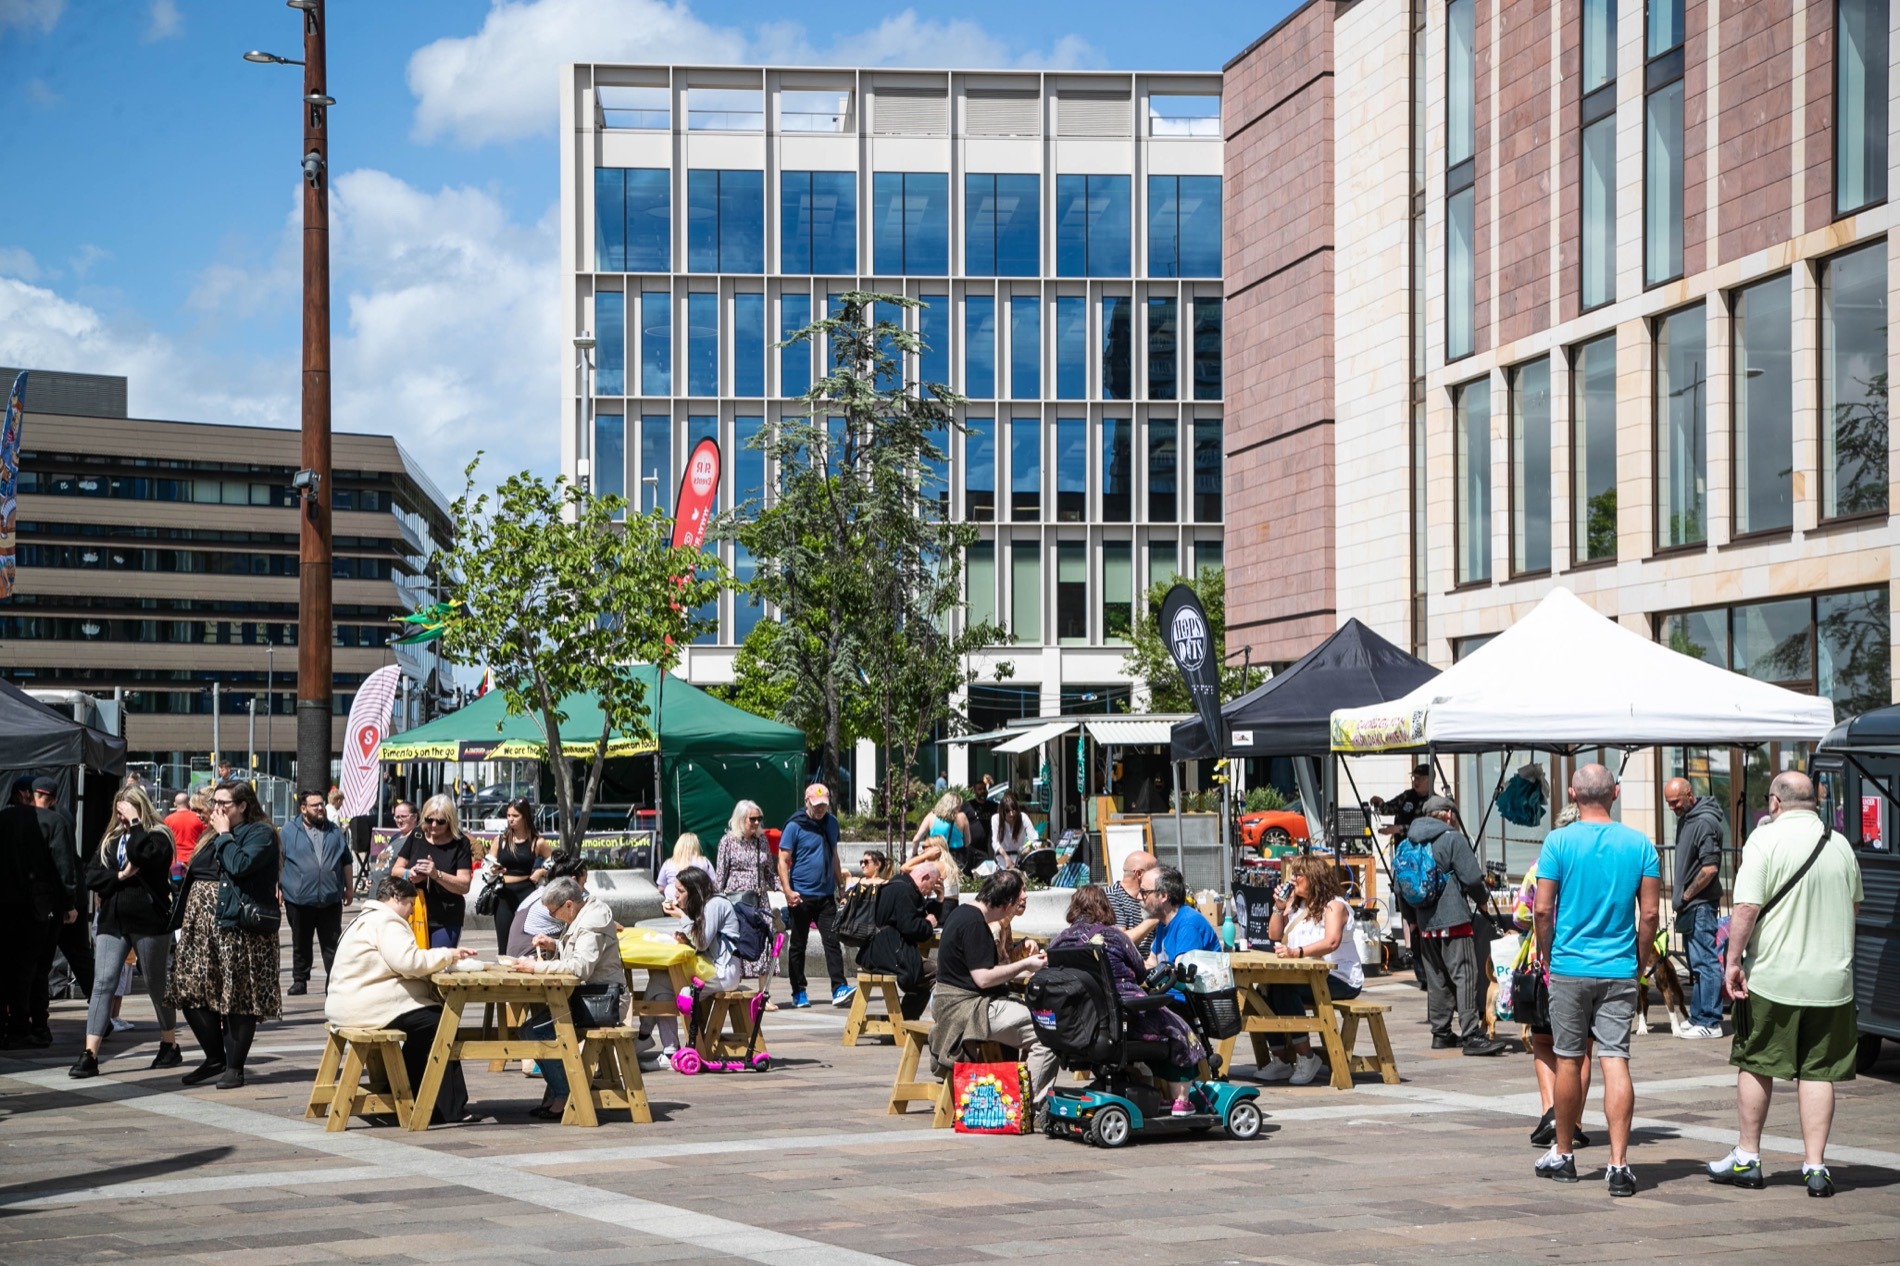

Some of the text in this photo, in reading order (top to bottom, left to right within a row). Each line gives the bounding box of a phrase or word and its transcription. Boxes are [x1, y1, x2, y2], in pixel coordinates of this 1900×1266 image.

[1174, 617, 1202, 639] HOPS
[1178, 639, 1204, 661] DOTS
[364, 730, 374, 746] S
[419, 749, 431, 758] on
[431, 747, 443, 757] the
[445, 748, 455, 760] go
[514, 746, 526, 755] are
[606, 741, 641, 751] amaican
[580, 837, 619, 849] amaican
[619, 836, 651, 848] Cuisine
